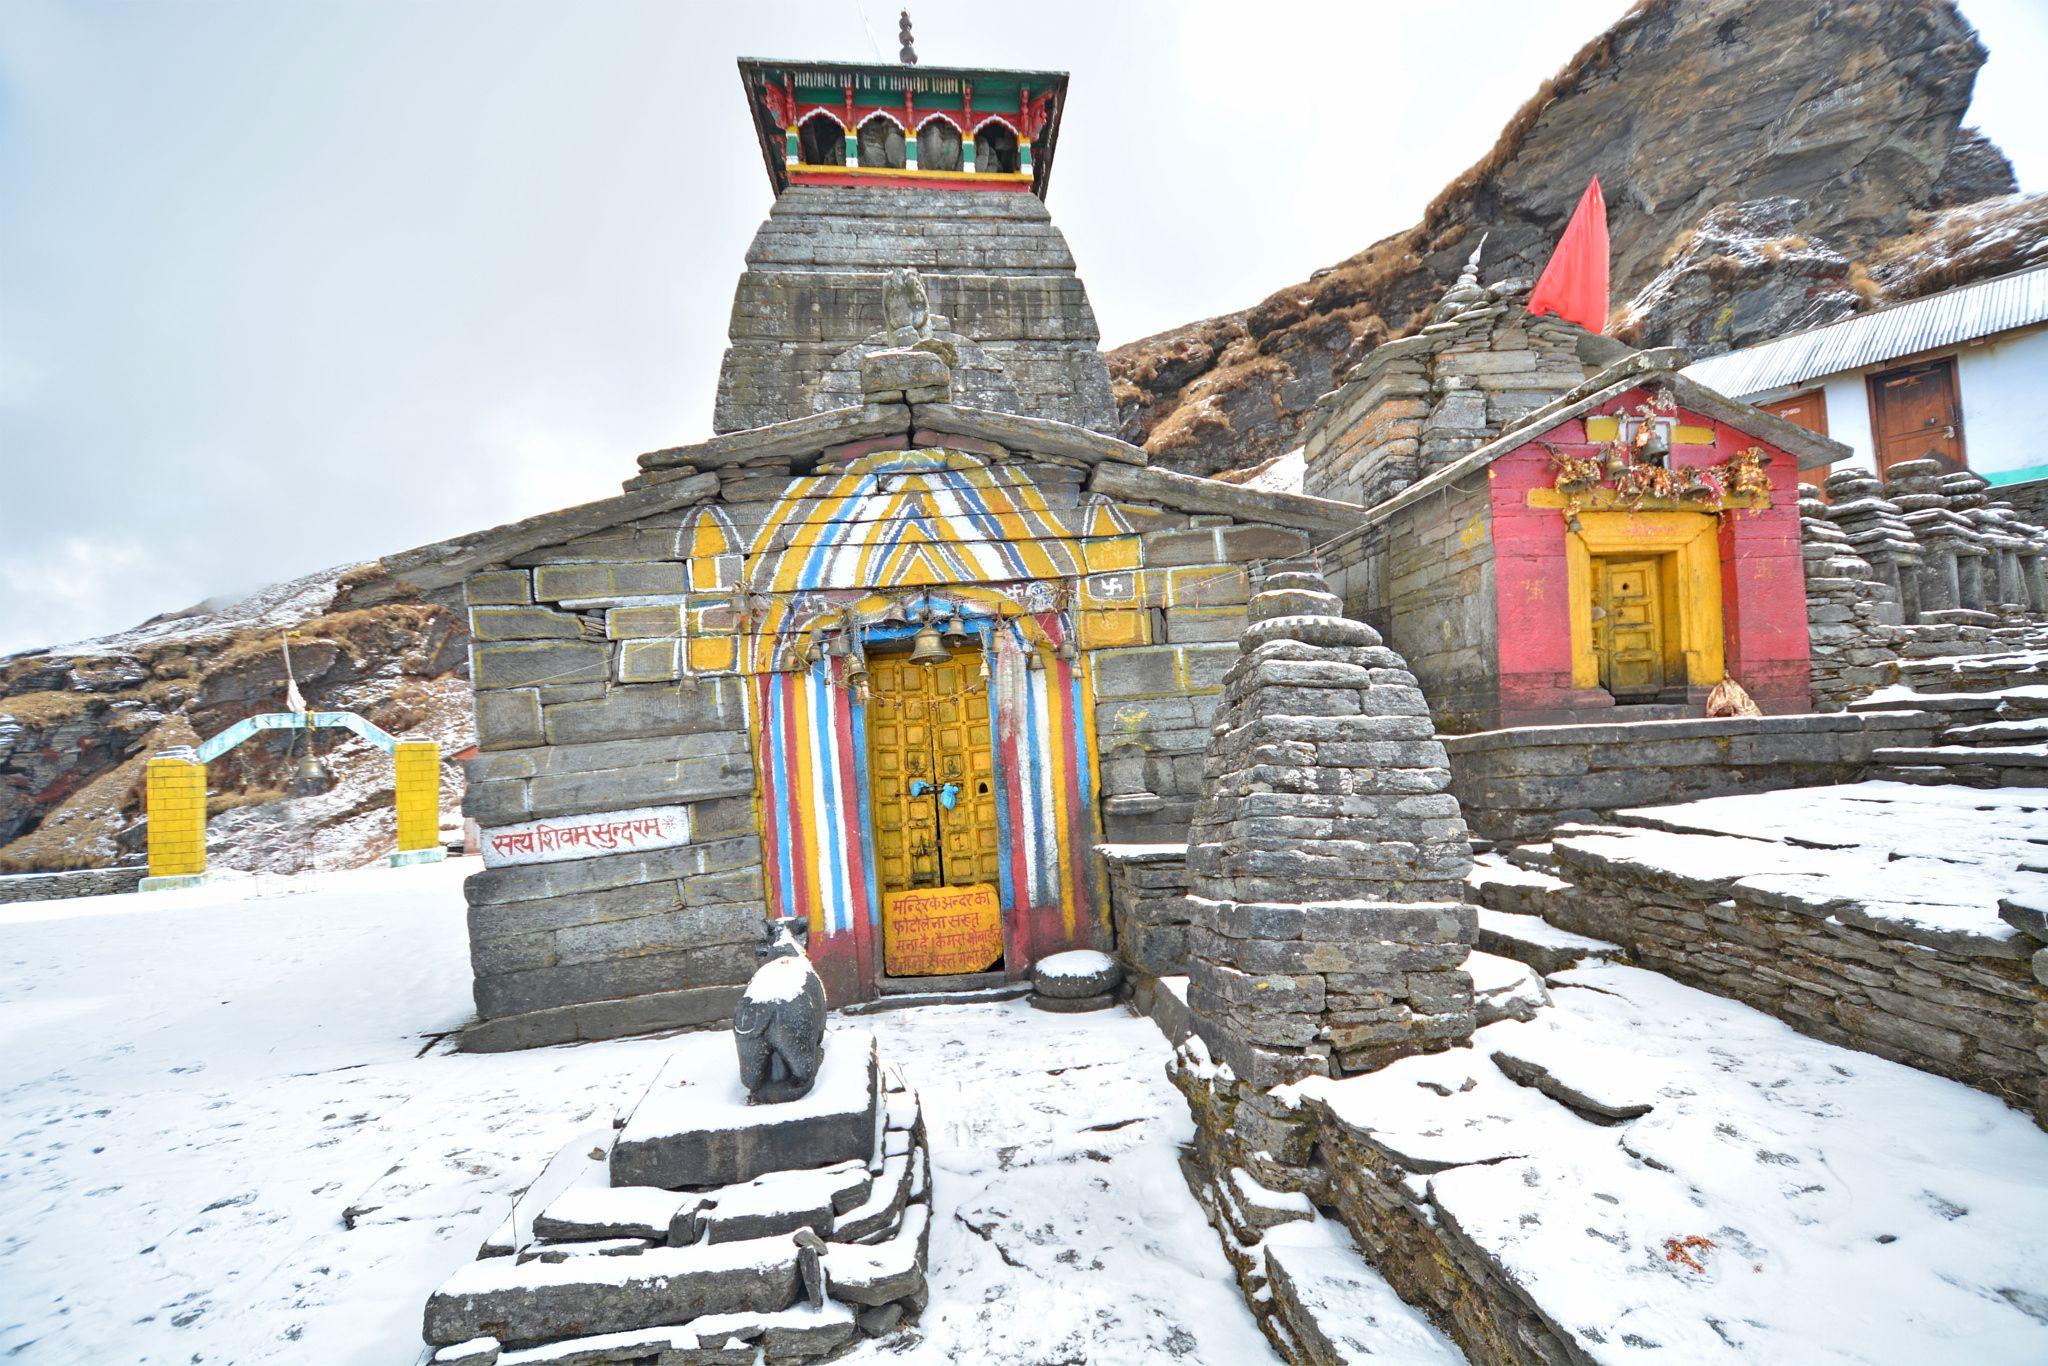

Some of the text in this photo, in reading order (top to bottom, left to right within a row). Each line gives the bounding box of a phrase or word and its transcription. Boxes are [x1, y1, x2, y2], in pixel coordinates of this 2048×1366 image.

[492, 817, 667, 857] सत्यं शिवम् सुन्दरम्
[893, 891, 990, 915] मन्दिर के अन्दर का
